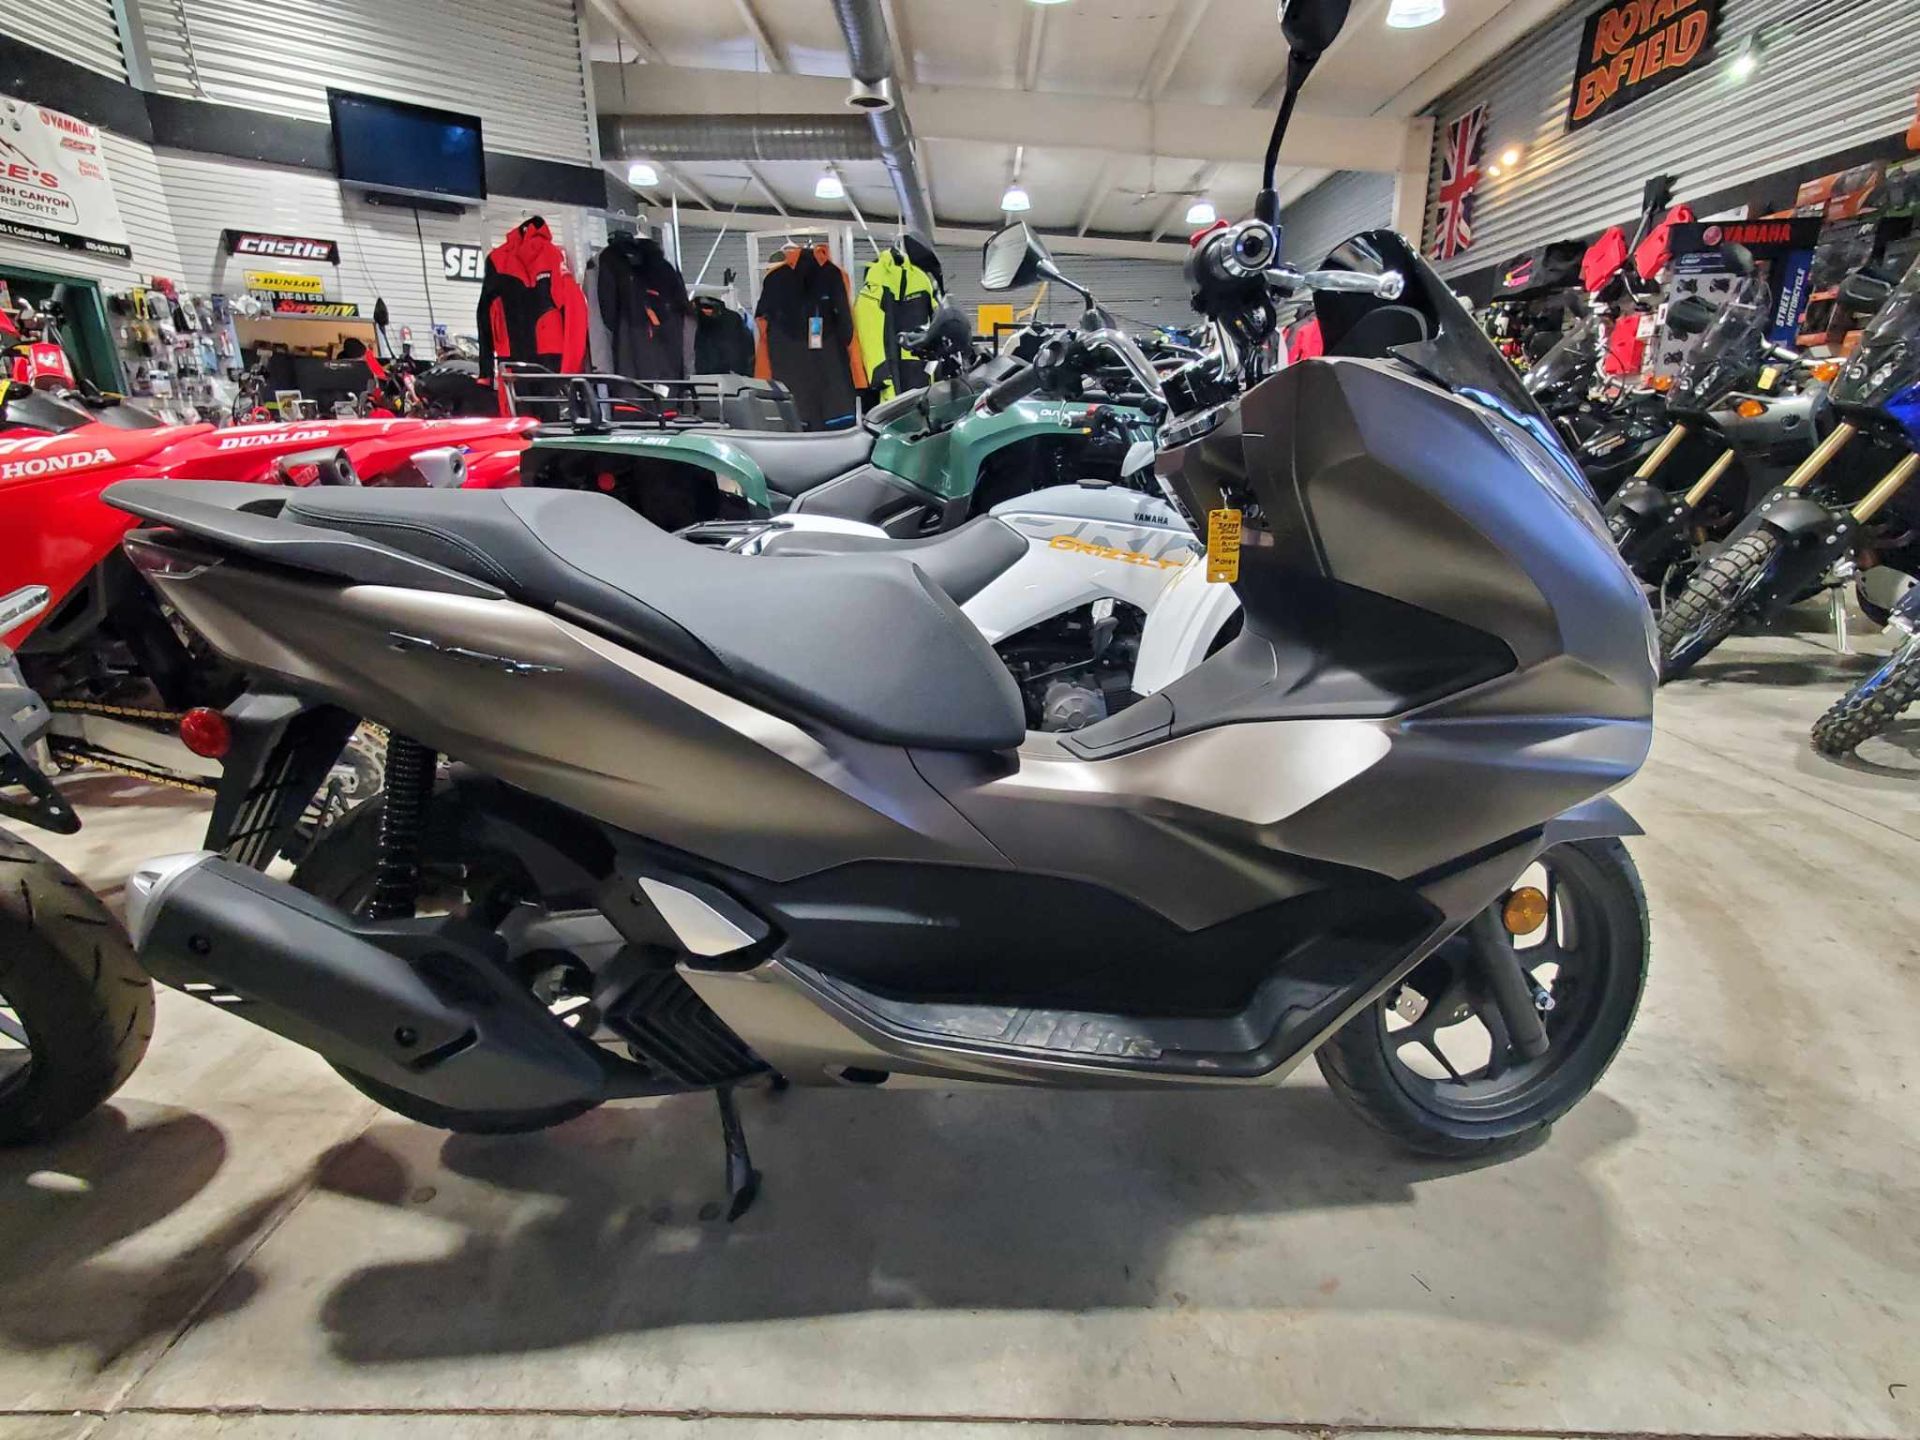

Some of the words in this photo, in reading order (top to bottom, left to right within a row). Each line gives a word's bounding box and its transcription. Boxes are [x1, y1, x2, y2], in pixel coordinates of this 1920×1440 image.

[1592, 0, 1697, 63] ROYA
[1573, 10, 1708, 120] ENFIELD
[19, 189, 69, 208] CANYON
[1723, 224, 1791, 243] YAMAHA
[262, 277, 320, 288] DUNLOP
[1776, 286, 1792, 327] STREET
[218, 430, 329, 450] DUNLOP
[1, 448, 117, 479] HONDA
[1133, 512, 1169, 526] YAMAHA
